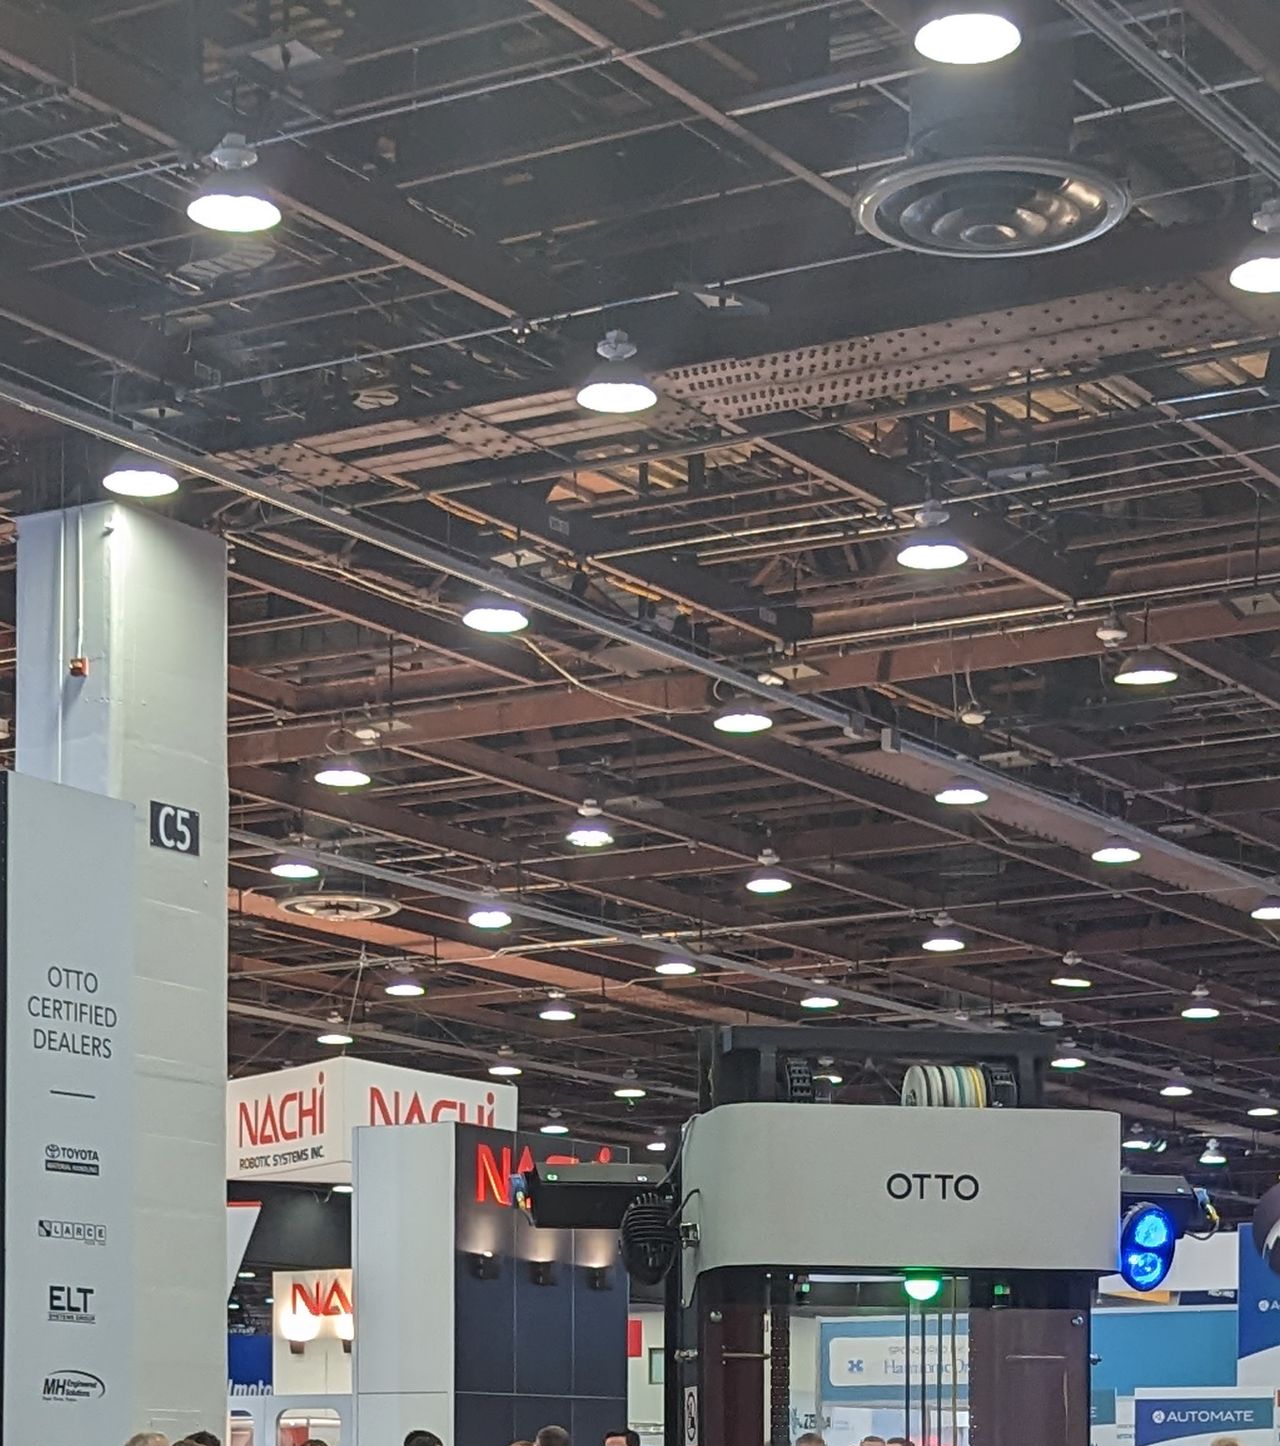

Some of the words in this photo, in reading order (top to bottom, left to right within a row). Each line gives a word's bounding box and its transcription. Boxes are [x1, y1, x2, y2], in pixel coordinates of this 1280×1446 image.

[158, 806, 193, 853] C5
[46, 965, 99, 994] OTTO
[27, 995, 118, 1029] CERTIFIED
[32, 1027, 113, 1061] DEALERS
[61, 1147, 100, 1162] TOYOTA
[239, 1154, 271, 1172] ROBOTIC
[272, 1149, 309, 1168] SYSTEMS
[886, 1173, 980, 1201] OTTO
[49, 1285, 94, 1313] ELT
[43, 1378, 67, 1396] MH
[1166, 1409, 1254, 1423] AUTOMATE
